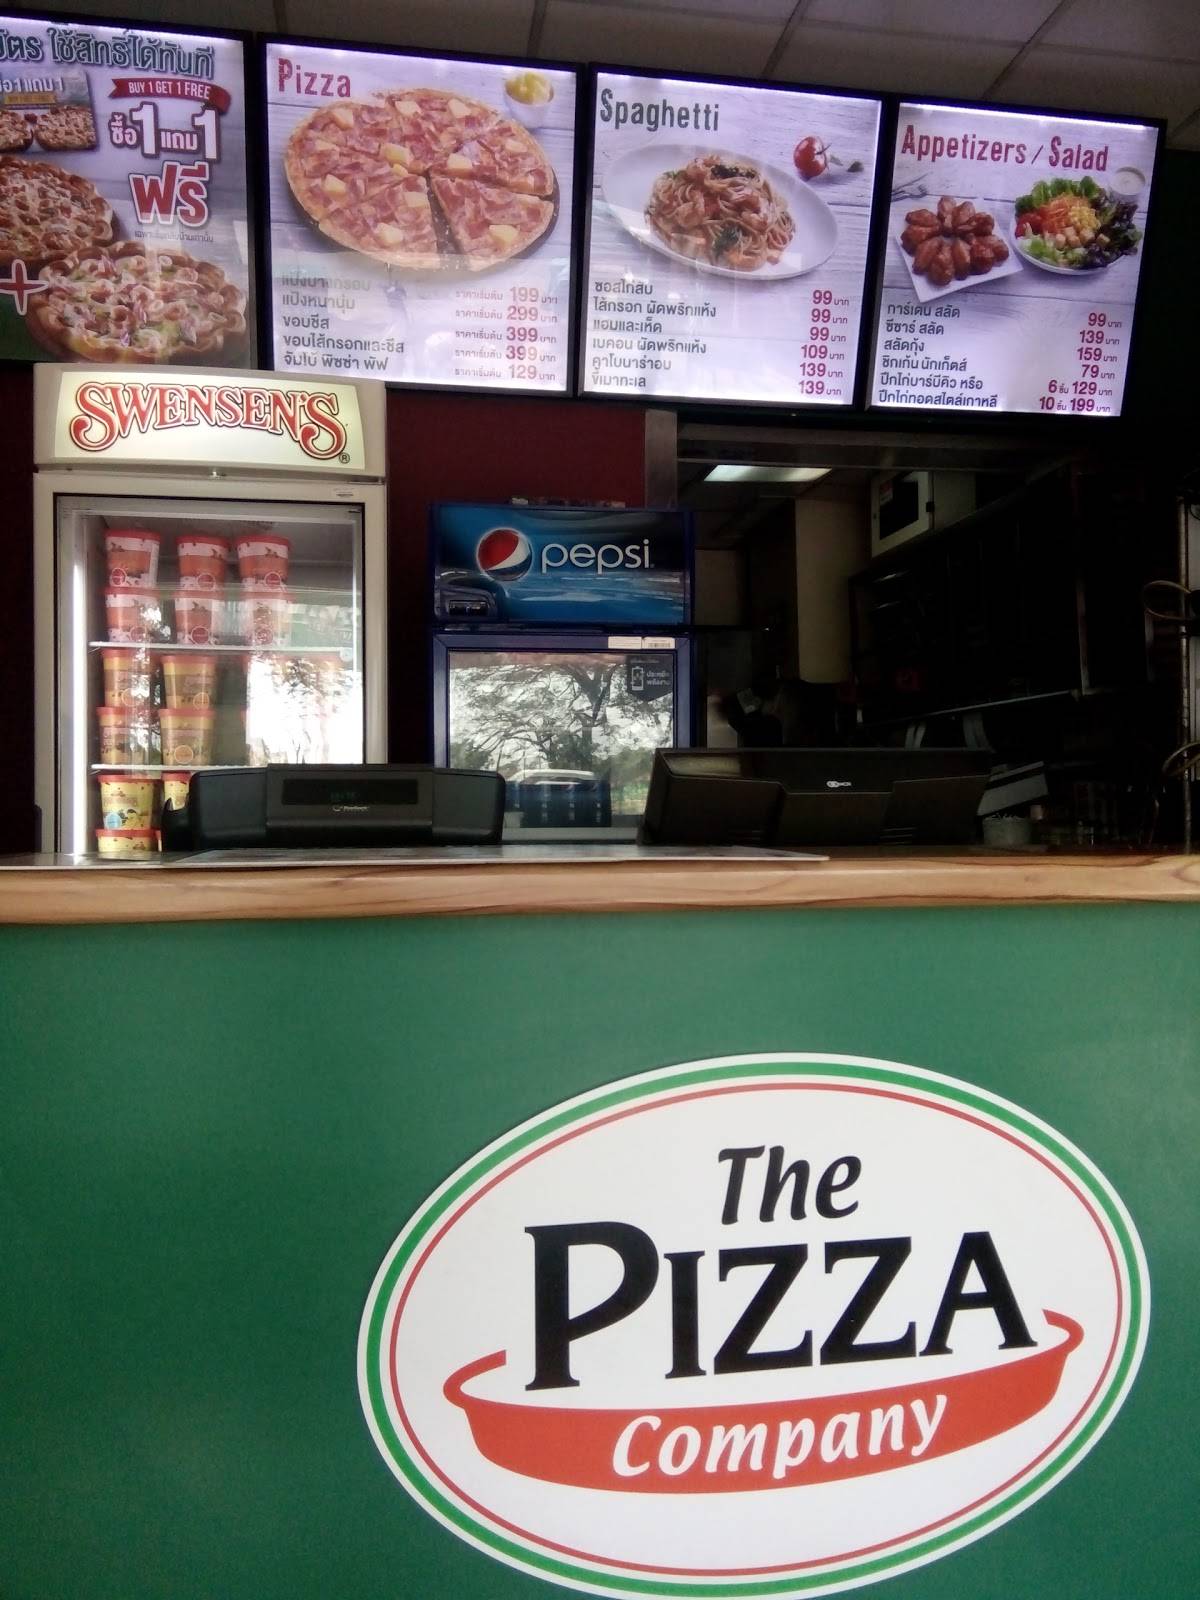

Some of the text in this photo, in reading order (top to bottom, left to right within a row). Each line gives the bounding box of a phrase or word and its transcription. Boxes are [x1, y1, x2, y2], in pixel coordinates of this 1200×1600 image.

[278, 58, 351, 98] Pizza
[128, 81, 212, 100] BUY 1 GET 1 FREE
[600, 88, 719, 132] Spaghetti
[901, 124, 1026, 163] Appetizers
[1049, 136, 1109, 172] Salad
[130, 162, 209, 227] ฟรี
[510, 286, 539, 302] 199
[595, 279, 653, 295] ซอสไก่สับ
[813, 290, 832, 305] 99
[507, 305, 539, 321] 299
[593, 296, 716, 318] ไส้กรอก ผัดพริกแห้ง
[888, 302, 960, 318] การ์เดน สลัด
[283, 314, 329, 329] ขอบชีส
[811, 308, 831, 323] 99
[1088, 312, 1107, 327] 99
[593, 316, 662, 334] แฮมและเห็ด
[886, 319, 944, 335] ซีซาร์ สลัด
[506, 326, 538, 342] 399
[810, 326, 829, 341] 99
[1080, 330, 1104, 344] 139
[283, 332, 404, 353] ขอบไส้กรอกและชีส
[592, 337, 707, 354] เบคอน ผัดพริกแห้ง
[884, 338, 925, 356] สลัดกุ้ง
[506, 345, 537, 361] 399
[801, 344, 828, 359] 109
[1077, 347, 1102, 361] 159
[800, 362, 826, 377] 139
[882, 355, 918, 369] ชิกเก้น
[509, 364, 537, 380] 129
[1082, 364, 1099, 378] 79
[799, 380, 825, 395] 139
[880, 372, 983, 390] ปีกไก่บาร์บีคิว หรือ
[1048, 379, 1058, 393] 6
[1072, 381, 1097, 395] 129
[879, 390, 998, 408] ปีกไก่ทอดสไตล์เกาหลี
[1040, 396, 1055, 410] 10
[1070, 398, 1095, 412] 199
[70, 381, 348, 460] SWENSEN'S
[541, 538, 650, 574] pepsi
[718, 1143, 862, 1227] The
[523, 1219, 1039, 1393] PIZZA
[612, 1394, 948, 1480] Company
